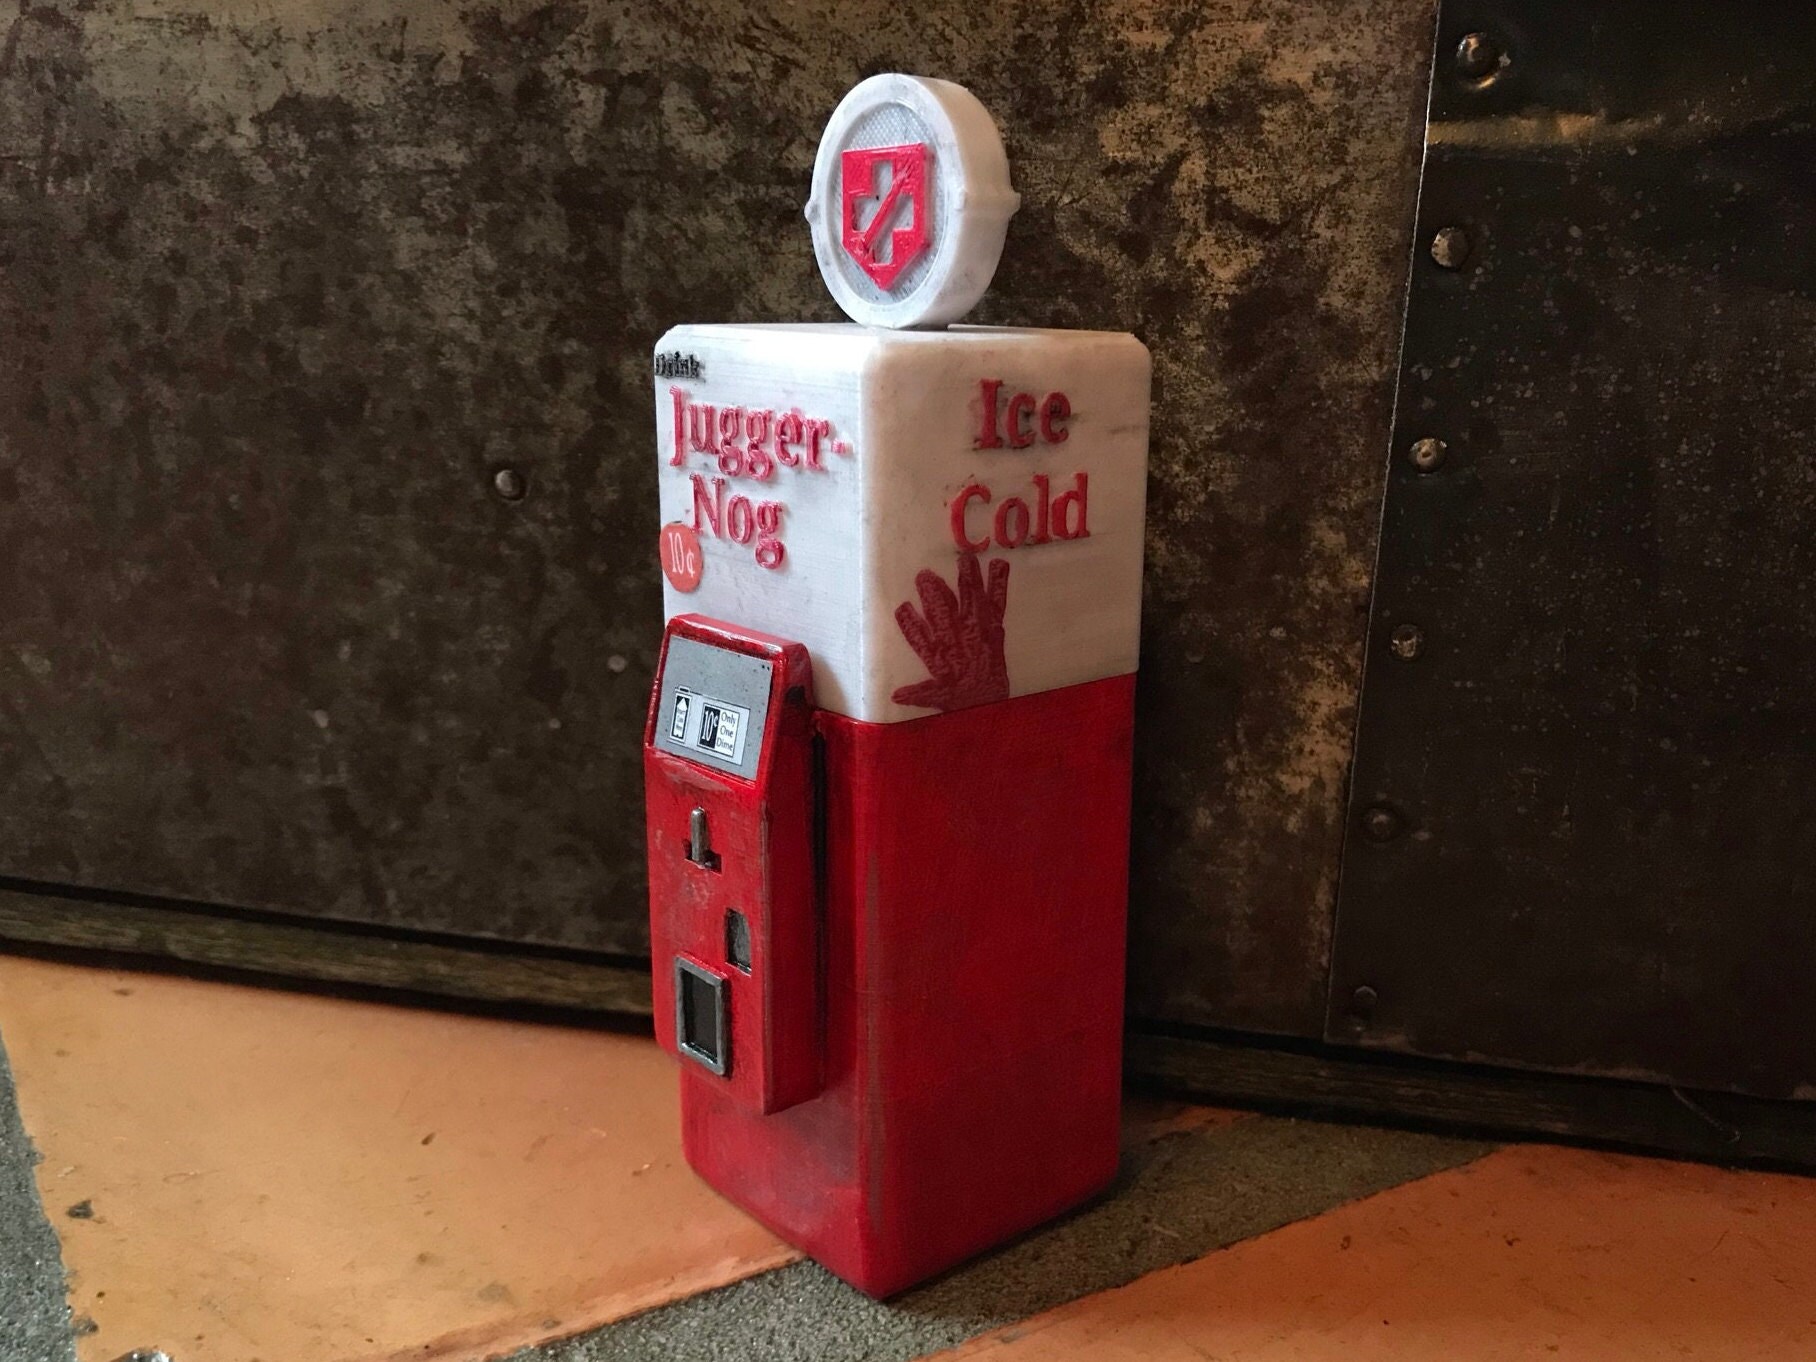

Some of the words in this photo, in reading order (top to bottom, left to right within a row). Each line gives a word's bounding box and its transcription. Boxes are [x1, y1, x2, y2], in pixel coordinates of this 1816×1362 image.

[973, 379, 1071, 450] Ice
[689, 473, 785, 570] Nog
[951, 472, 1091, 555] Cold
[720, 725, 733, 737] One
[721, 712, 735, 727] Only
[716, 738, 733, 751] Dime
